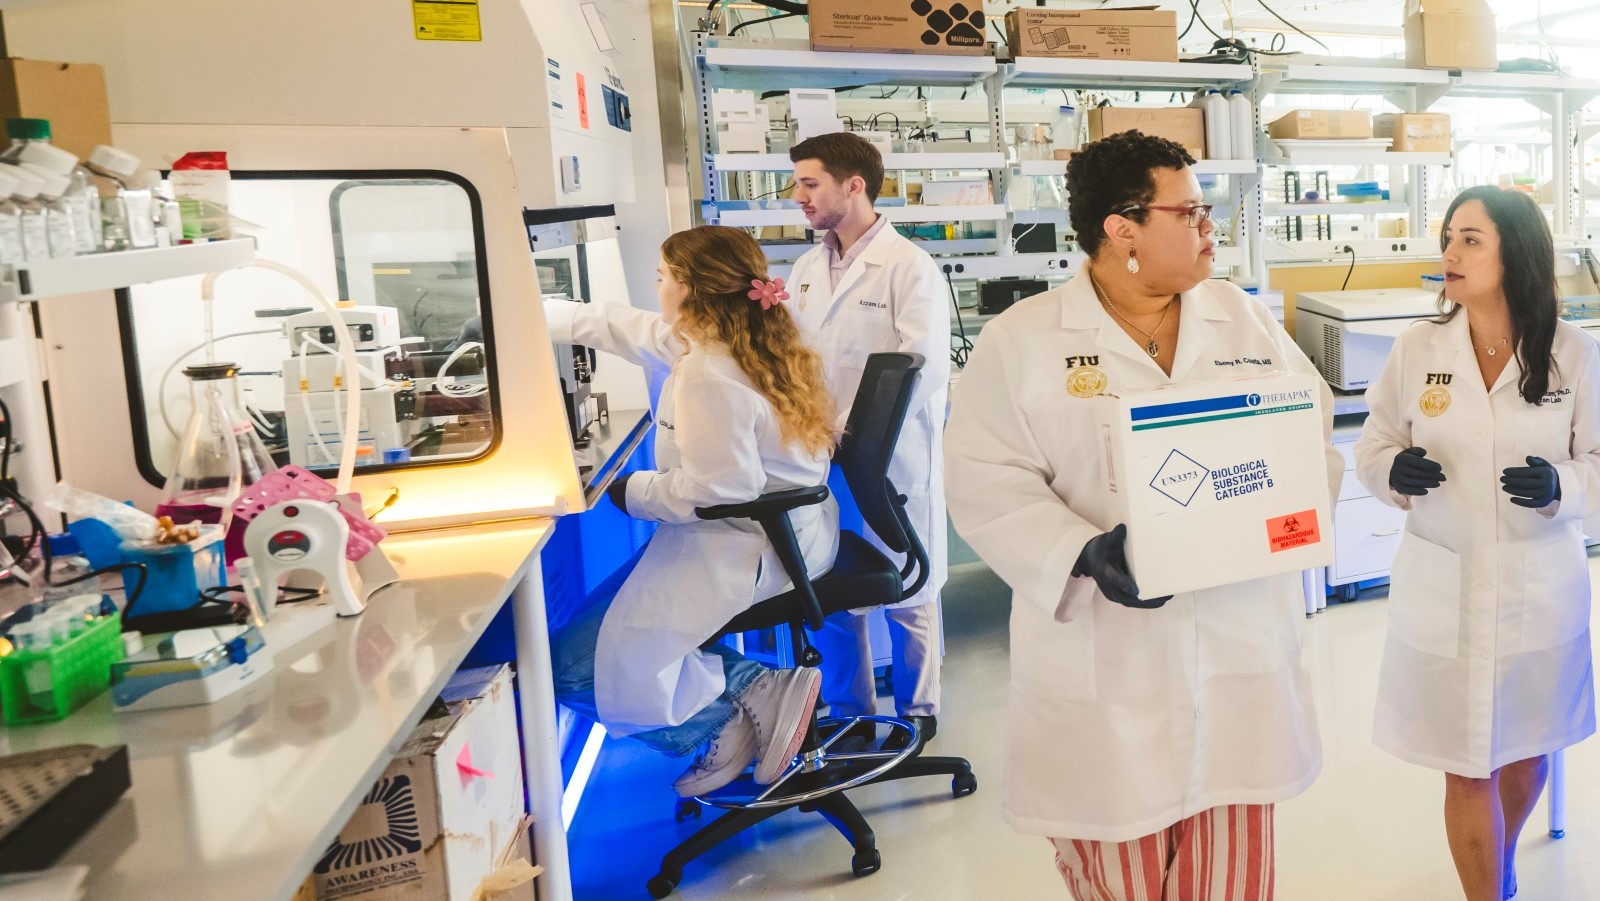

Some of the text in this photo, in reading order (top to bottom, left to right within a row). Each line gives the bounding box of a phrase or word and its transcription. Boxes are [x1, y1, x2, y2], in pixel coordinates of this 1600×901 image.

[864, 14, 882, 22] Quick
[1065, 355, 1099, 369] FIU
[1425, 373, 1453, 385] FIU
[1254, 403, 1312, 415] INSULATED SHIPPER
[1210, 458, 1268, 480] BIOLOGICAL
[1161, 470, 1199, 487] UN3373
[1212, 468, 1270, 491] SUBSTANCE
[1215, 478, 1274, 501] CATEGORY B
[1271, 529, 1315, 544] BIOHAZARDOUS
[1280, 537, 1308, 549] MATERIAL
[326, 859, 417, 887] AWARENESS
